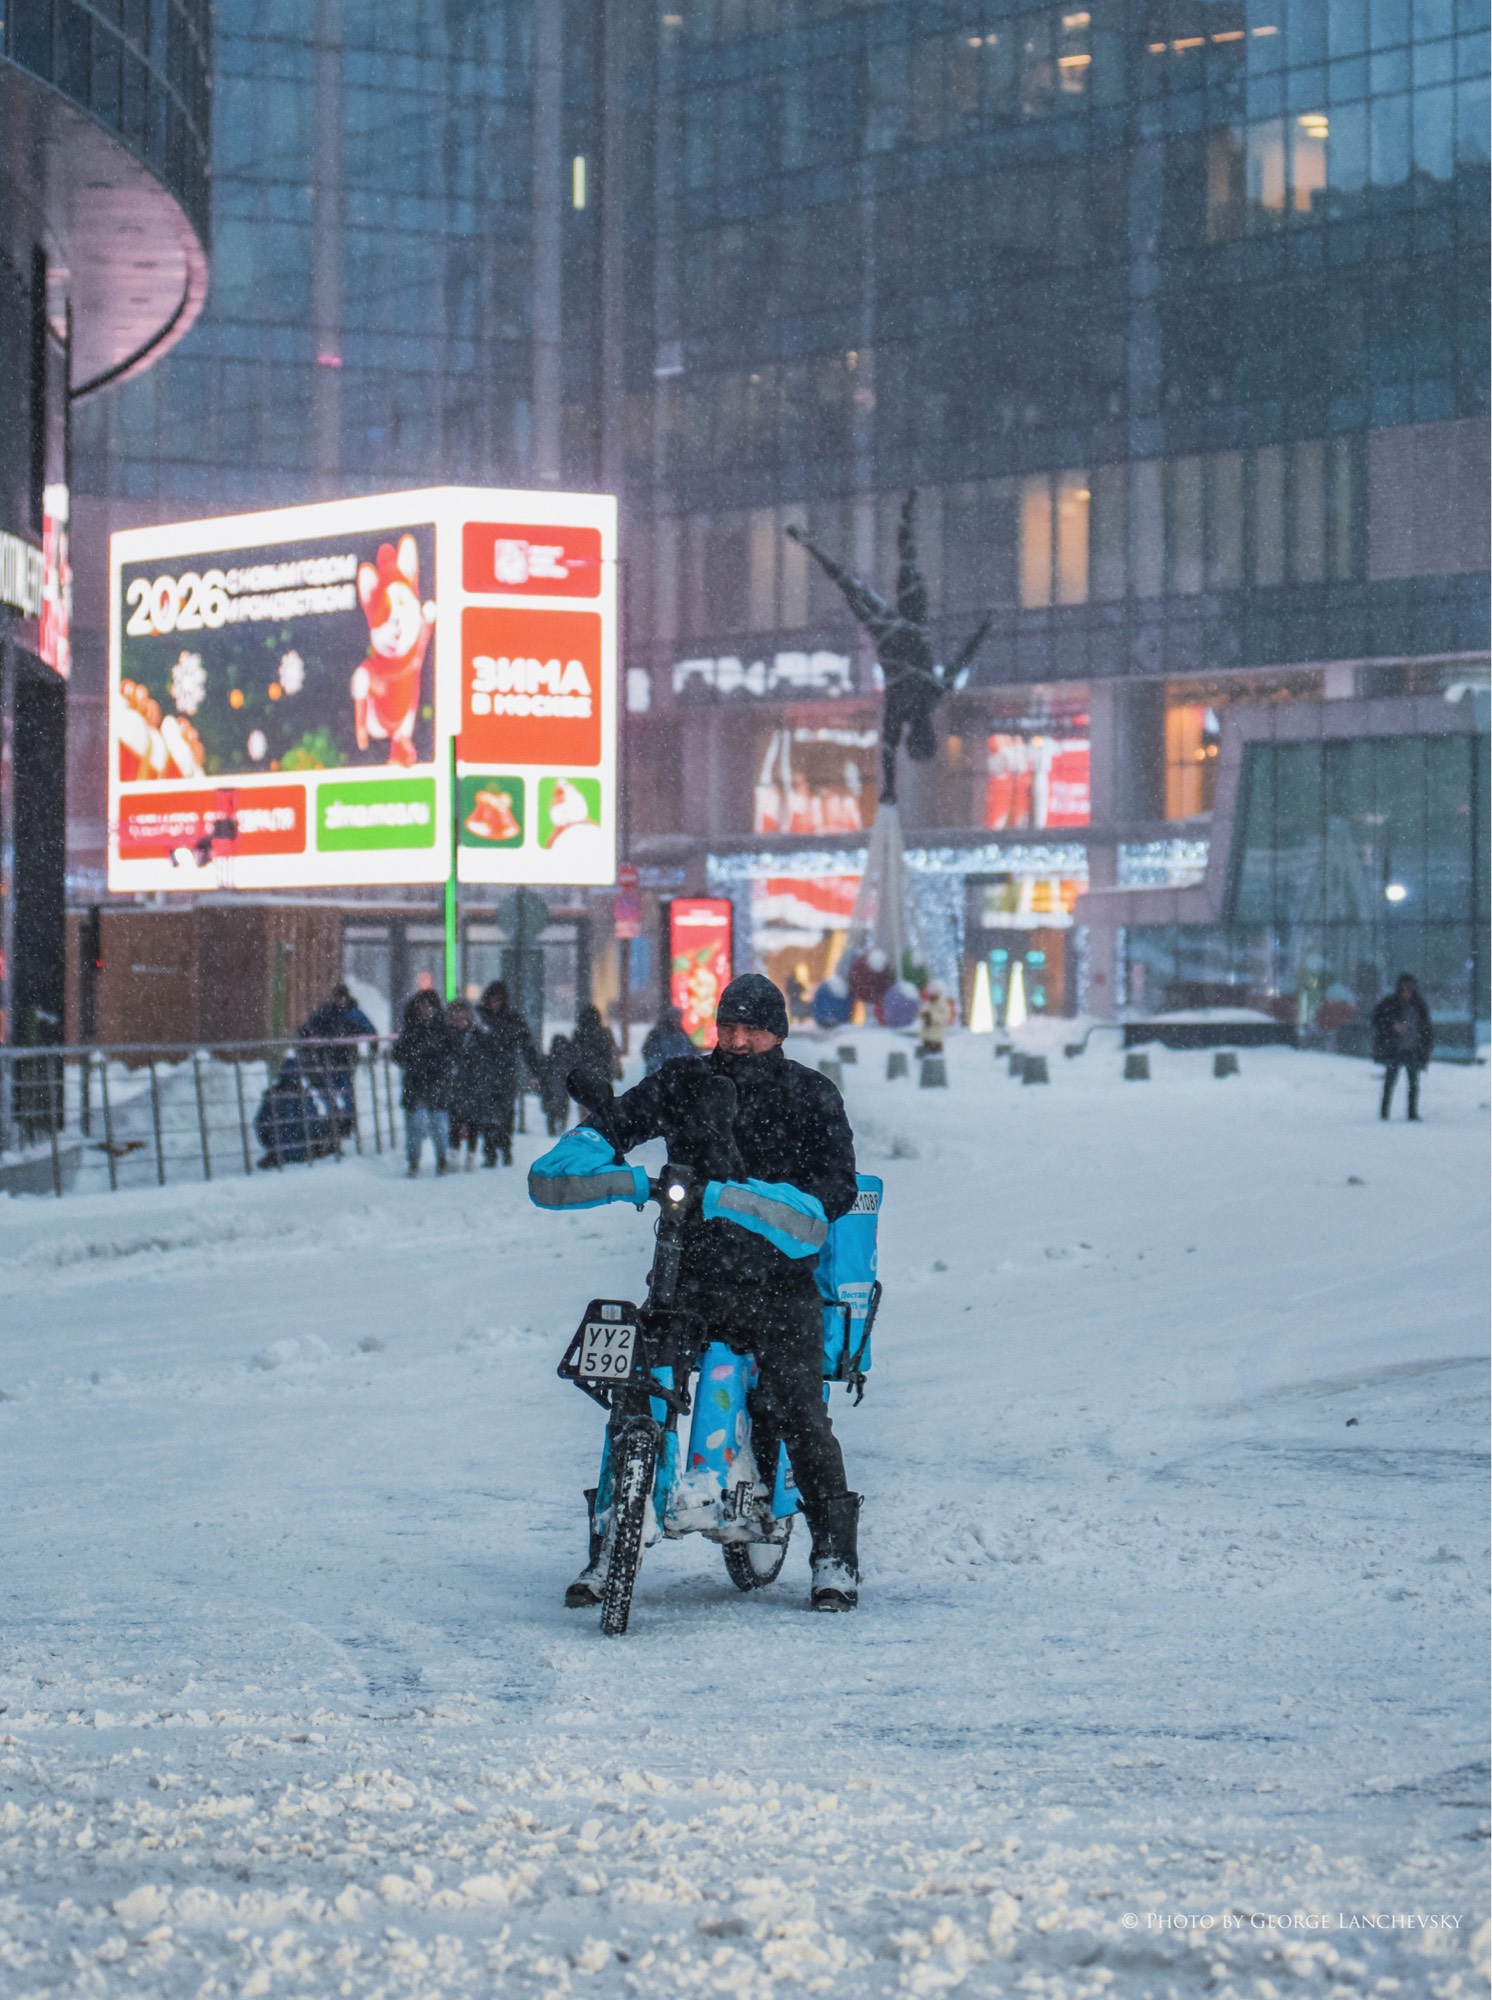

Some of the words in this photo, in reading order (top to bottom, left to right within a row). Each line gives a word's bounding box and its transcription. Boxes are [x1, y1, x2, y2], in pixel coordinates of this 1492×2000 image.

[126, 570, 228, 636] 2026
[472, 656, 592, 695] ЗИМА
[584, 1352, 628, 1374] 590
